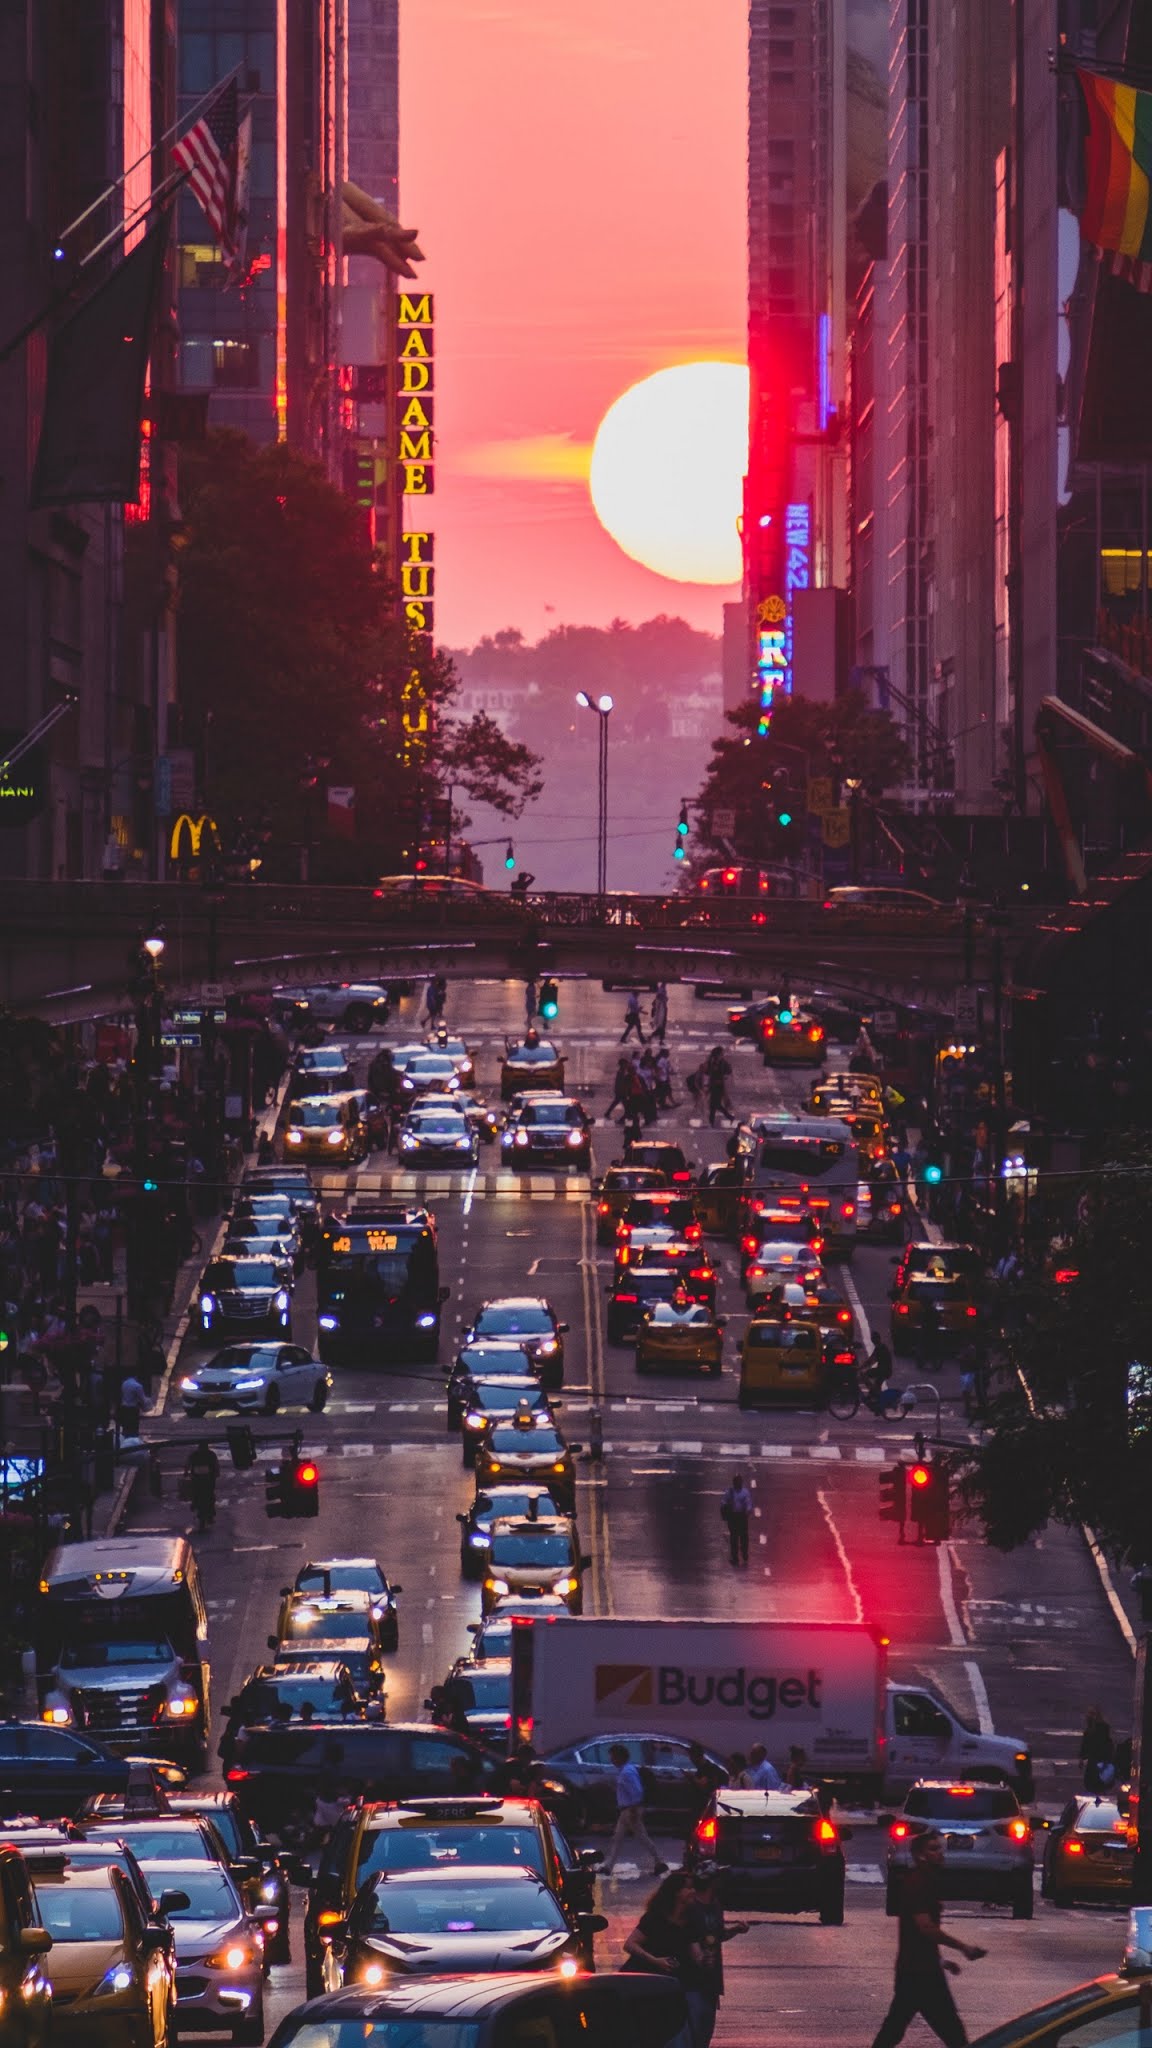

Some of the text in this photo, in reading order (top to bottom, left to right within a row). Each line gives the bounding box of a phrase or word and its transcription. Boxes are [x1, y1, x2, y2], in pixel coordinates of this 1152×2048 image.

[398, 293, 432, 495] MADAME
[787, 504, 809, 589] NEW 42
[658, 1666, 823, 1721] Budget
